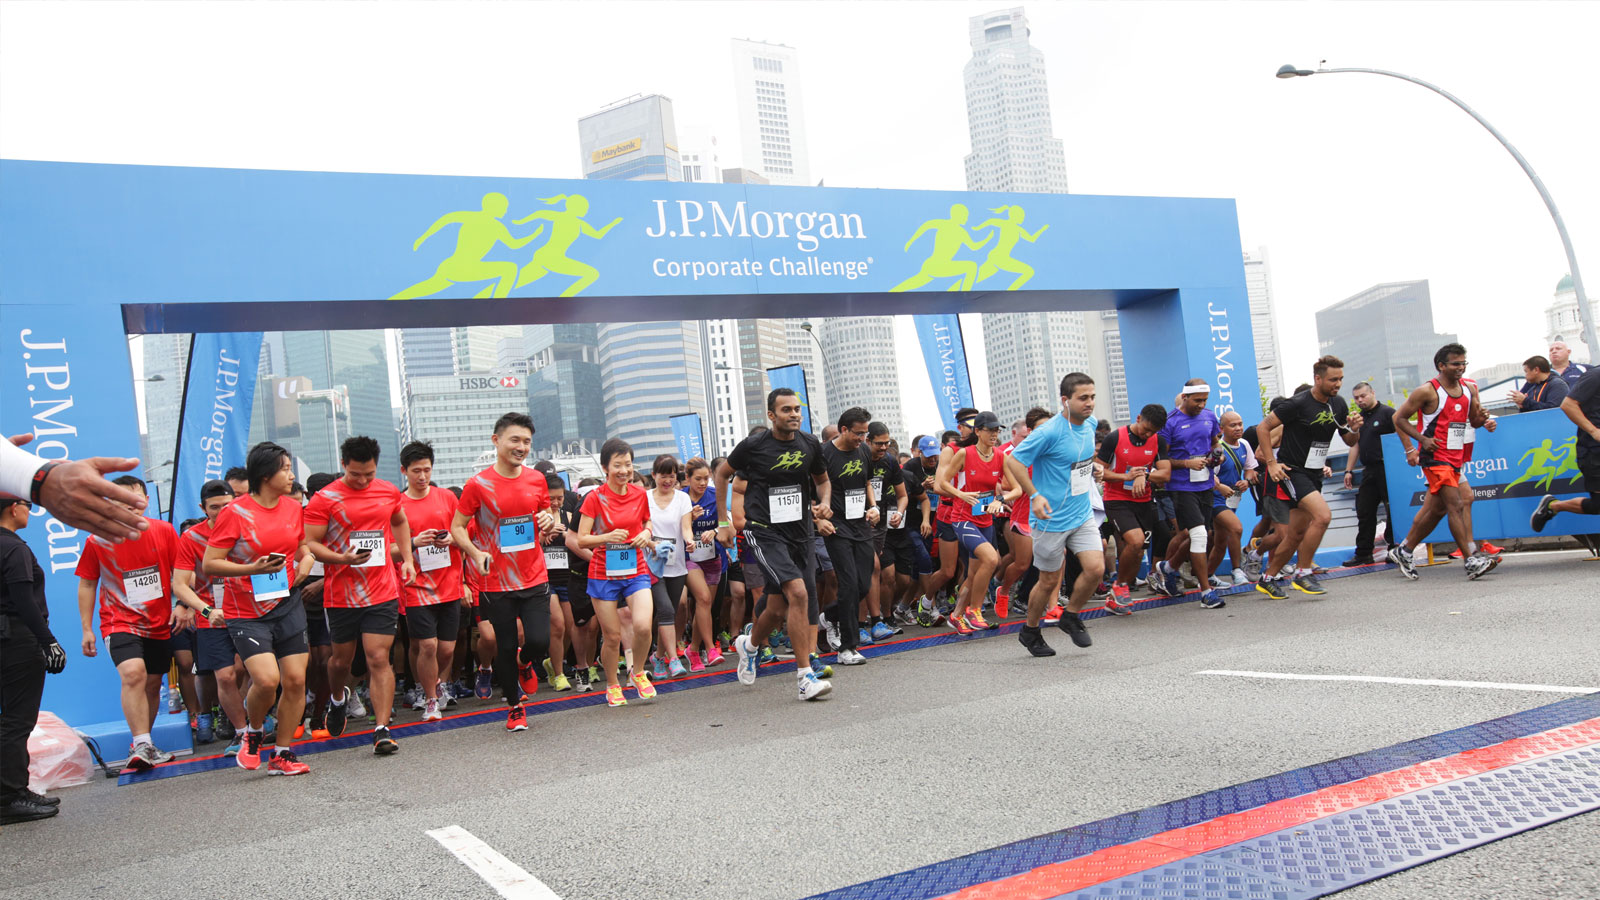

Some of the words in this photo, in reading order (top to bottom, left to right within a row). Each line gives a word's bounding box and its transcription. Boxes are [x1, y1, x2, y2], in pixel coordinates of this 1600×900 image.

[601, 141, 636, 158] Maybank
[646, 199, 867, 252] J.P.Morgan
[652, 257, 763, 280] Corporate
[1208, 302, 1238, 421] J.P.Morg
[459, 377, 498, 390] HSBC
[20, 328, 80, 575] J.P.Moan
[689, 433, 701, 458] J.P.M
[777, 494, 800, 506] 11570
[504, 517, 529, 525] J.P.Morgan
[355, 531, 381, 539] J.P.Morgan
[515, 525, 525, 535] 90
[359, 540, 382, 549] 14281
[610, 543, 630, 551] J.P.Morg
[620, 551, 629, 560] 80
[133, 573, 159, 588] 14280
